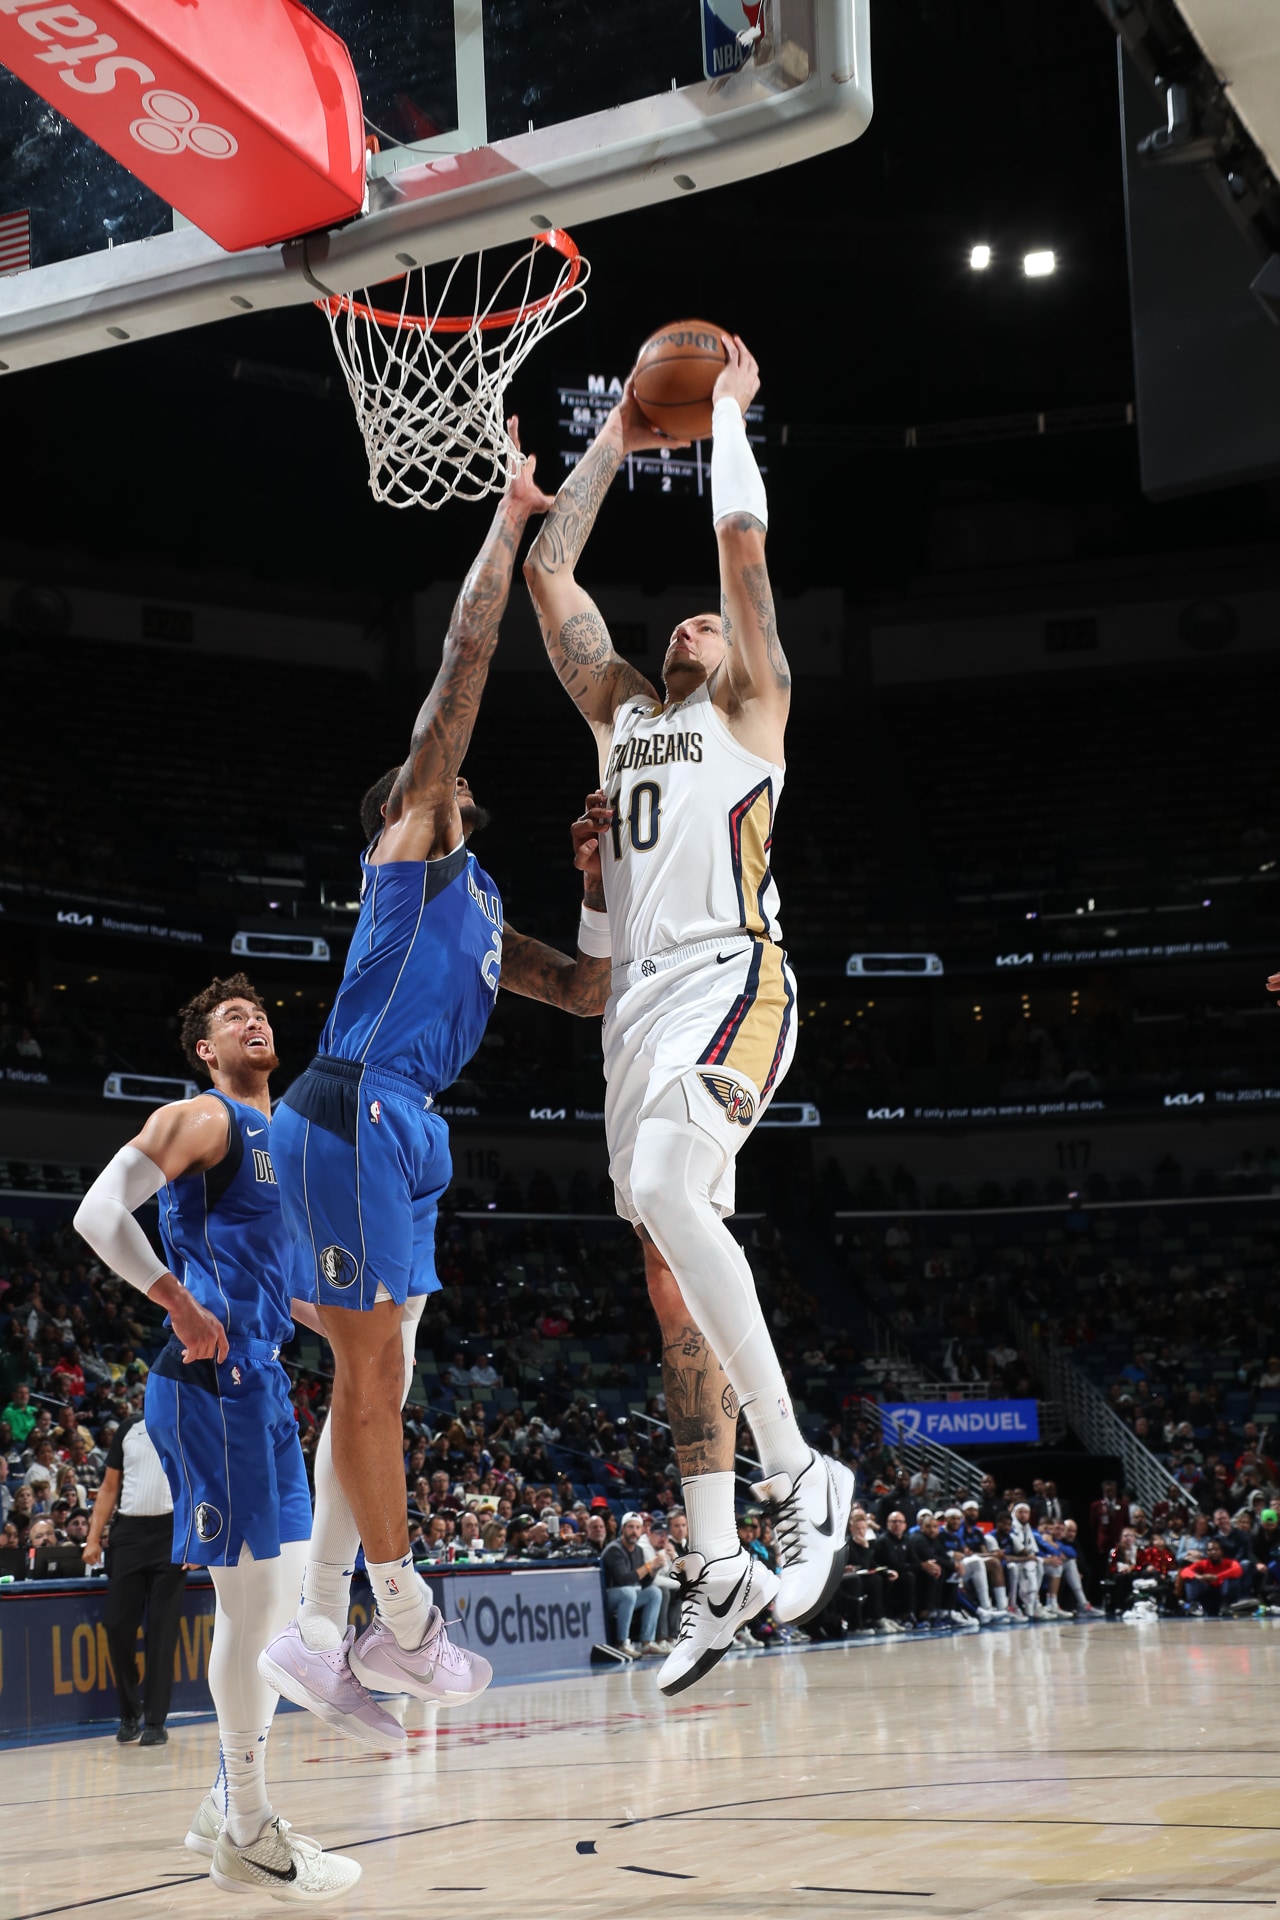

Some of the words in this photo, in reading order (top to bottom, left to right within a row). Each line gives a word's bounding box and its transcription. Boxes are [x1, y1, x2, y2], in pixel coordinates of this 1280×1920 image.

[0, 0, 155, 94] Sta
[713, 43, 744, 73] NBA
[662, 476, 671, 492] 2
[611, 780, 662, 861] 10
[57, 910, 93, 927] KIA
[102, 917, 149, 935] Movement
[150, 924, 168, 937] that
[996, 952, 1034, 967] KIA
[1163, 1091, 1205, 1106] KIA
[529, 1108, 566, 1120] KIA
[867, 1107, 905, 1120] KIA
[464, 1149, 500, 1180] 116
[1055, 1139, 1091, 1170] 117
[683, 1343, 701, 1357] 27
[927, 1413, 1027, 1433] FANDUEL
[475, 1594, 592, 1646] Ochsner
[173, 1614, 214, 1683] IVE
